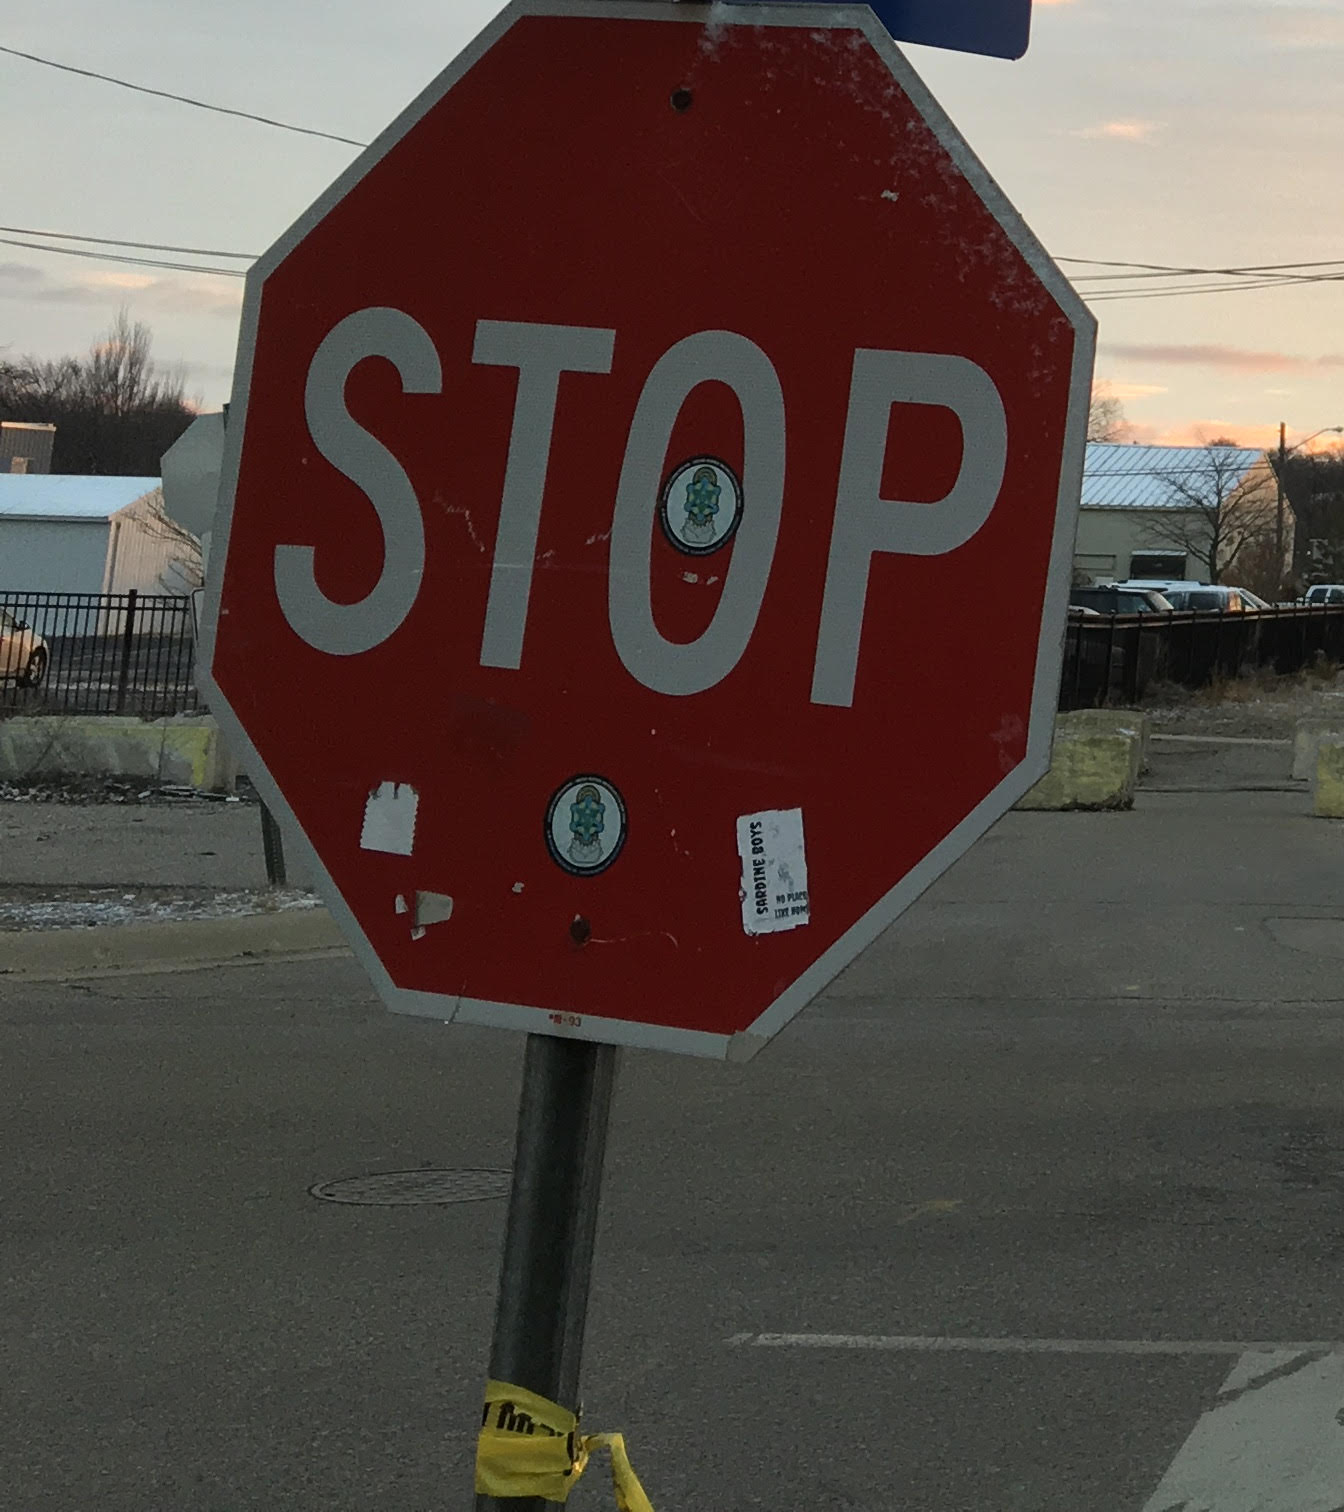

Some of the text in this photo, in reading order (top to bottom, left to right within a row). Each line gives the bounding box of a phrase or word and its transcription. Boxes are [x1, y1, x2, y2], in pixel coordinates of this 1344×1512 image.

[273, 305, 1009, 708] STOP
[749, 821, 769, 915] SARDINE BOYS
